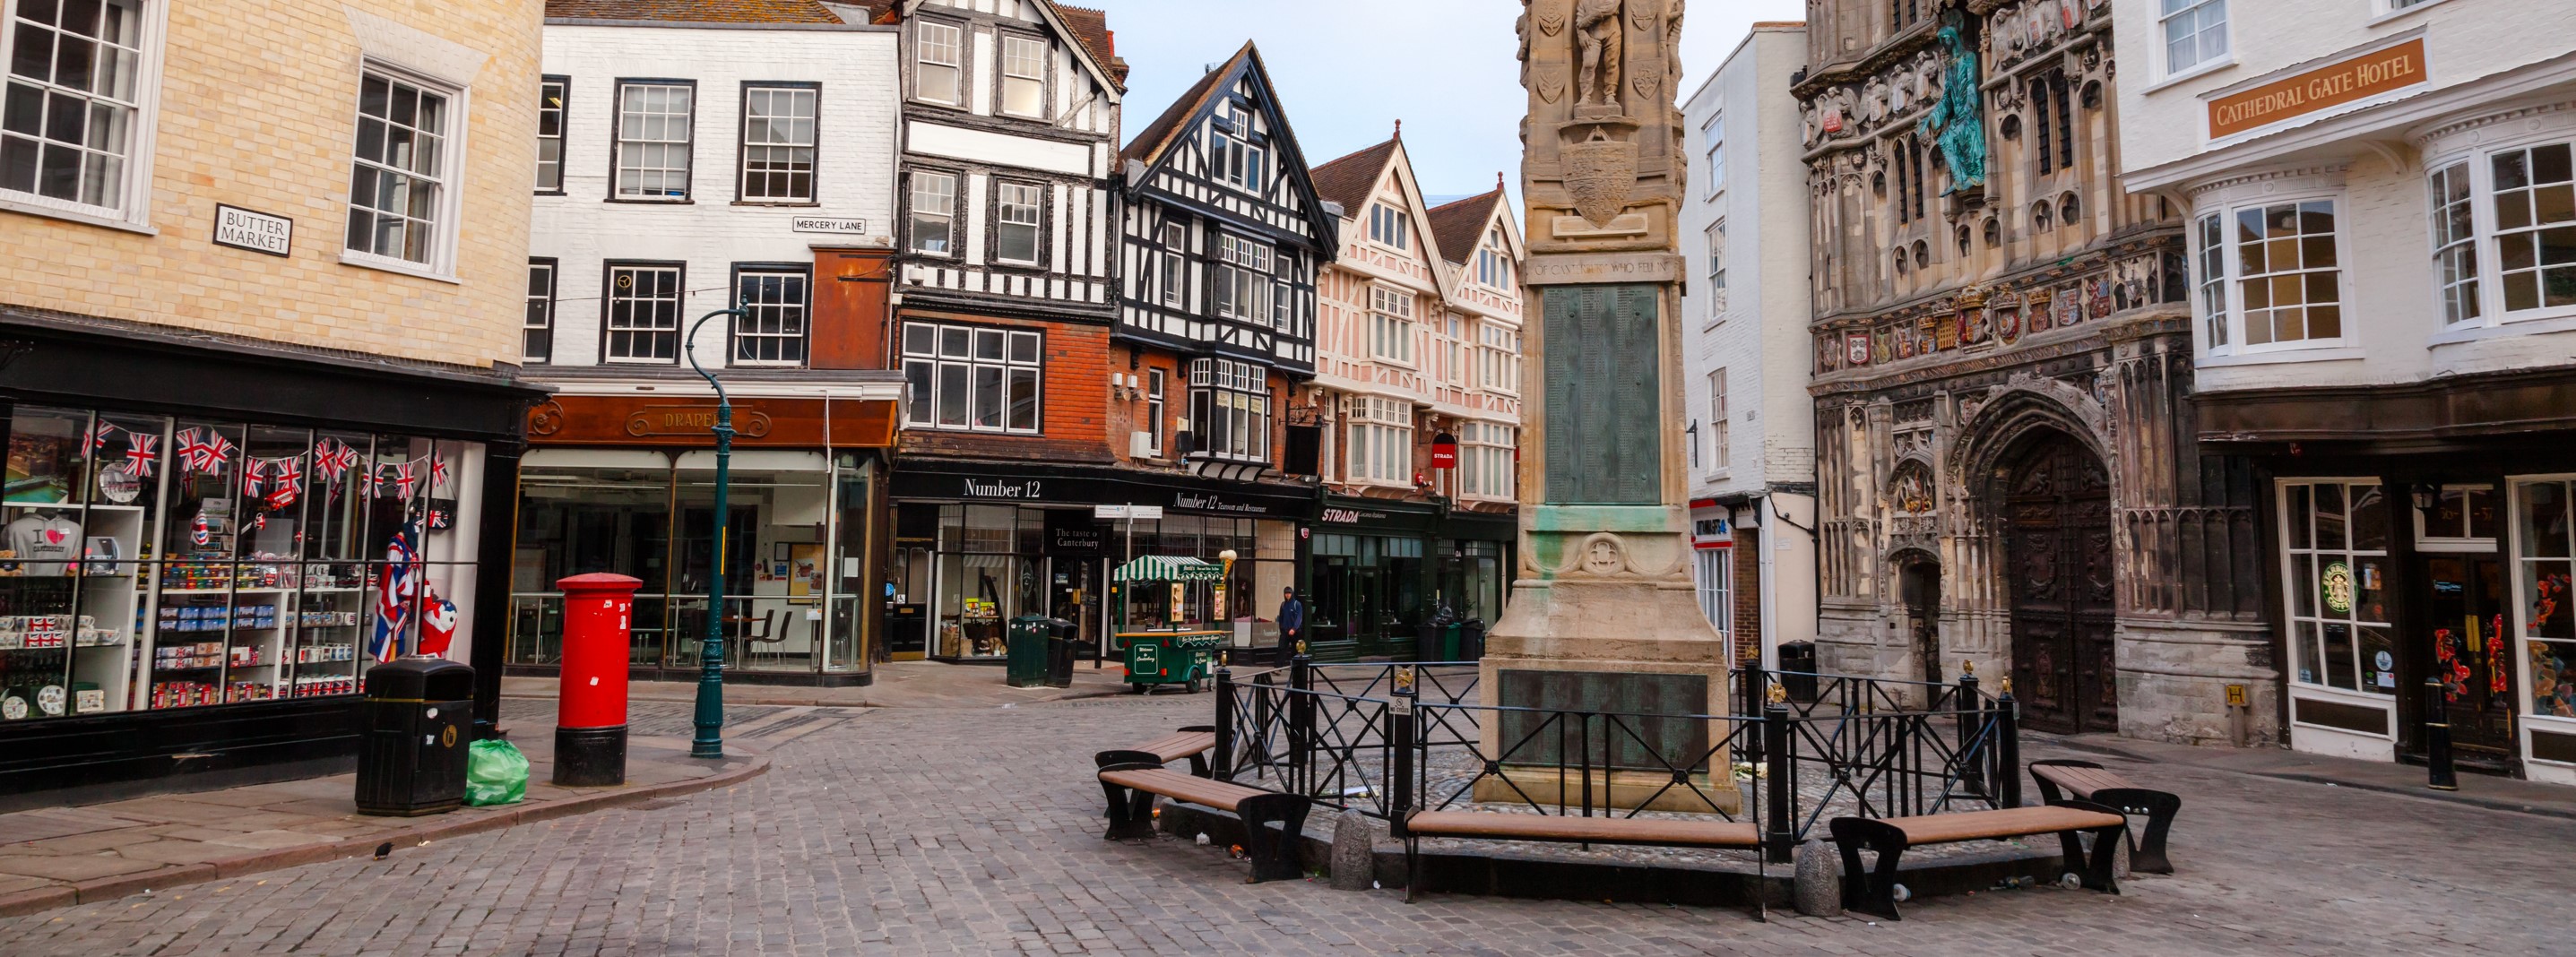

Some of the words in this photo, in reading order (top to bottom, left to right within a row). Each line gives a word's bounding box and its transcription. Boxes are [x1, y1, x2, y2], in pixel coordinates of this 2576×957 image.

[2217, 85, 2305, 126] CATHEDRAL
[2308, 72, 2354, 100] GATE
[2357, 54, 2415, 88] HOTEL
[226, 211, 284, 236] BUTTER
[796, 220, 837, 229] MERCERY
[839, 221, 862, 230] LANE
[220, 226, 286, 251] MARKET
[1611, 263, 1635, 273] WHO
[963, 478, 1022, 497] Number
[1024, 480, 1041, 498] 12
[1172, 492, 1206, 510] Number
[1206, 495, 1218, 510] 12
[1217, 502, 1236, 511] Tearoom
[1244, 504, 1266, 513] Restaurant
[1321, 508, 1359, 523] STRADA
[32, 530, 43, 544] I
[1055, 528, 1070, 537] The
[1057, 538, 1099, 550] Canterbury
[2328, 596, 2350, 610] COFFE
